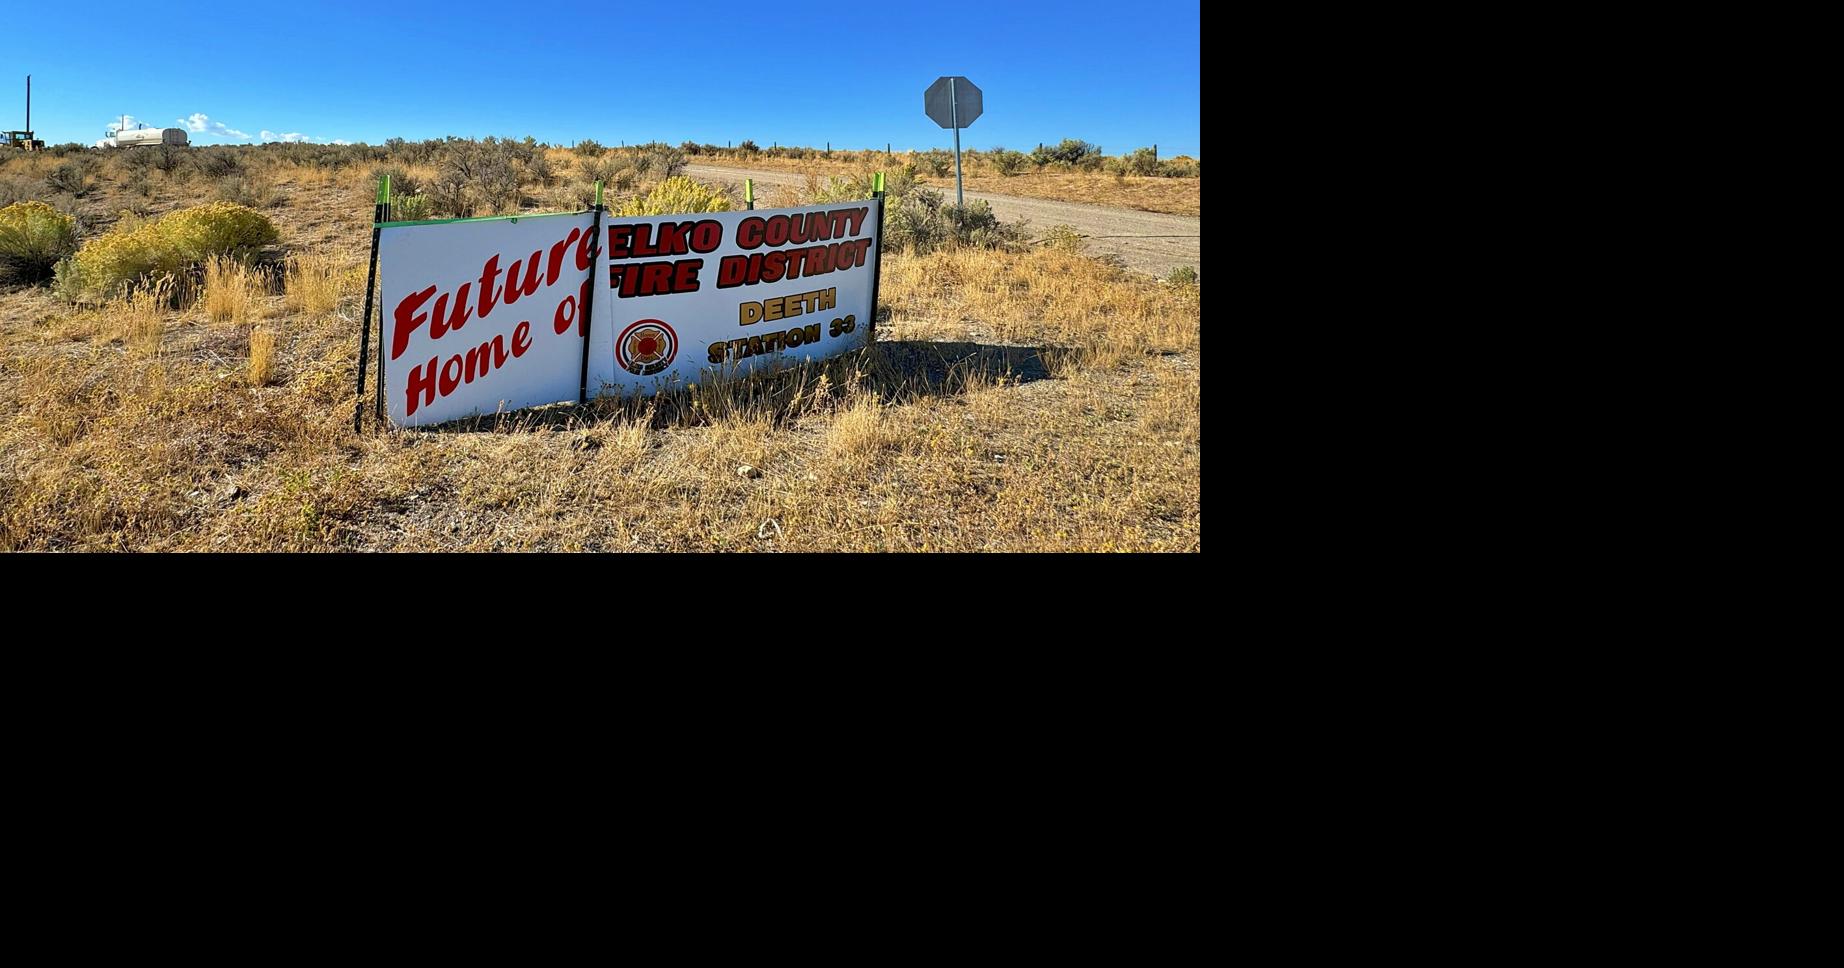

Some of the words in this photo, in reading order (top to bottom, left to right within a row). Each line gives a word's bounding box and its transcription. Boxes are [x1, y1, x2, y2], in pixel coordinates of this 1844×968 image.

[608, 219, 723, 259] ELKO
[736, 206, 869, 249] COUNTY
[716, 237, 872, 289] DISTRICT
[391, 225, 602, 361] Future
[739, 287, 837, 326] DEETH
[707, 322, 821, 364] STATION
[829, 314, 856, 338] 33
[405, 320, 533, 417] Home
